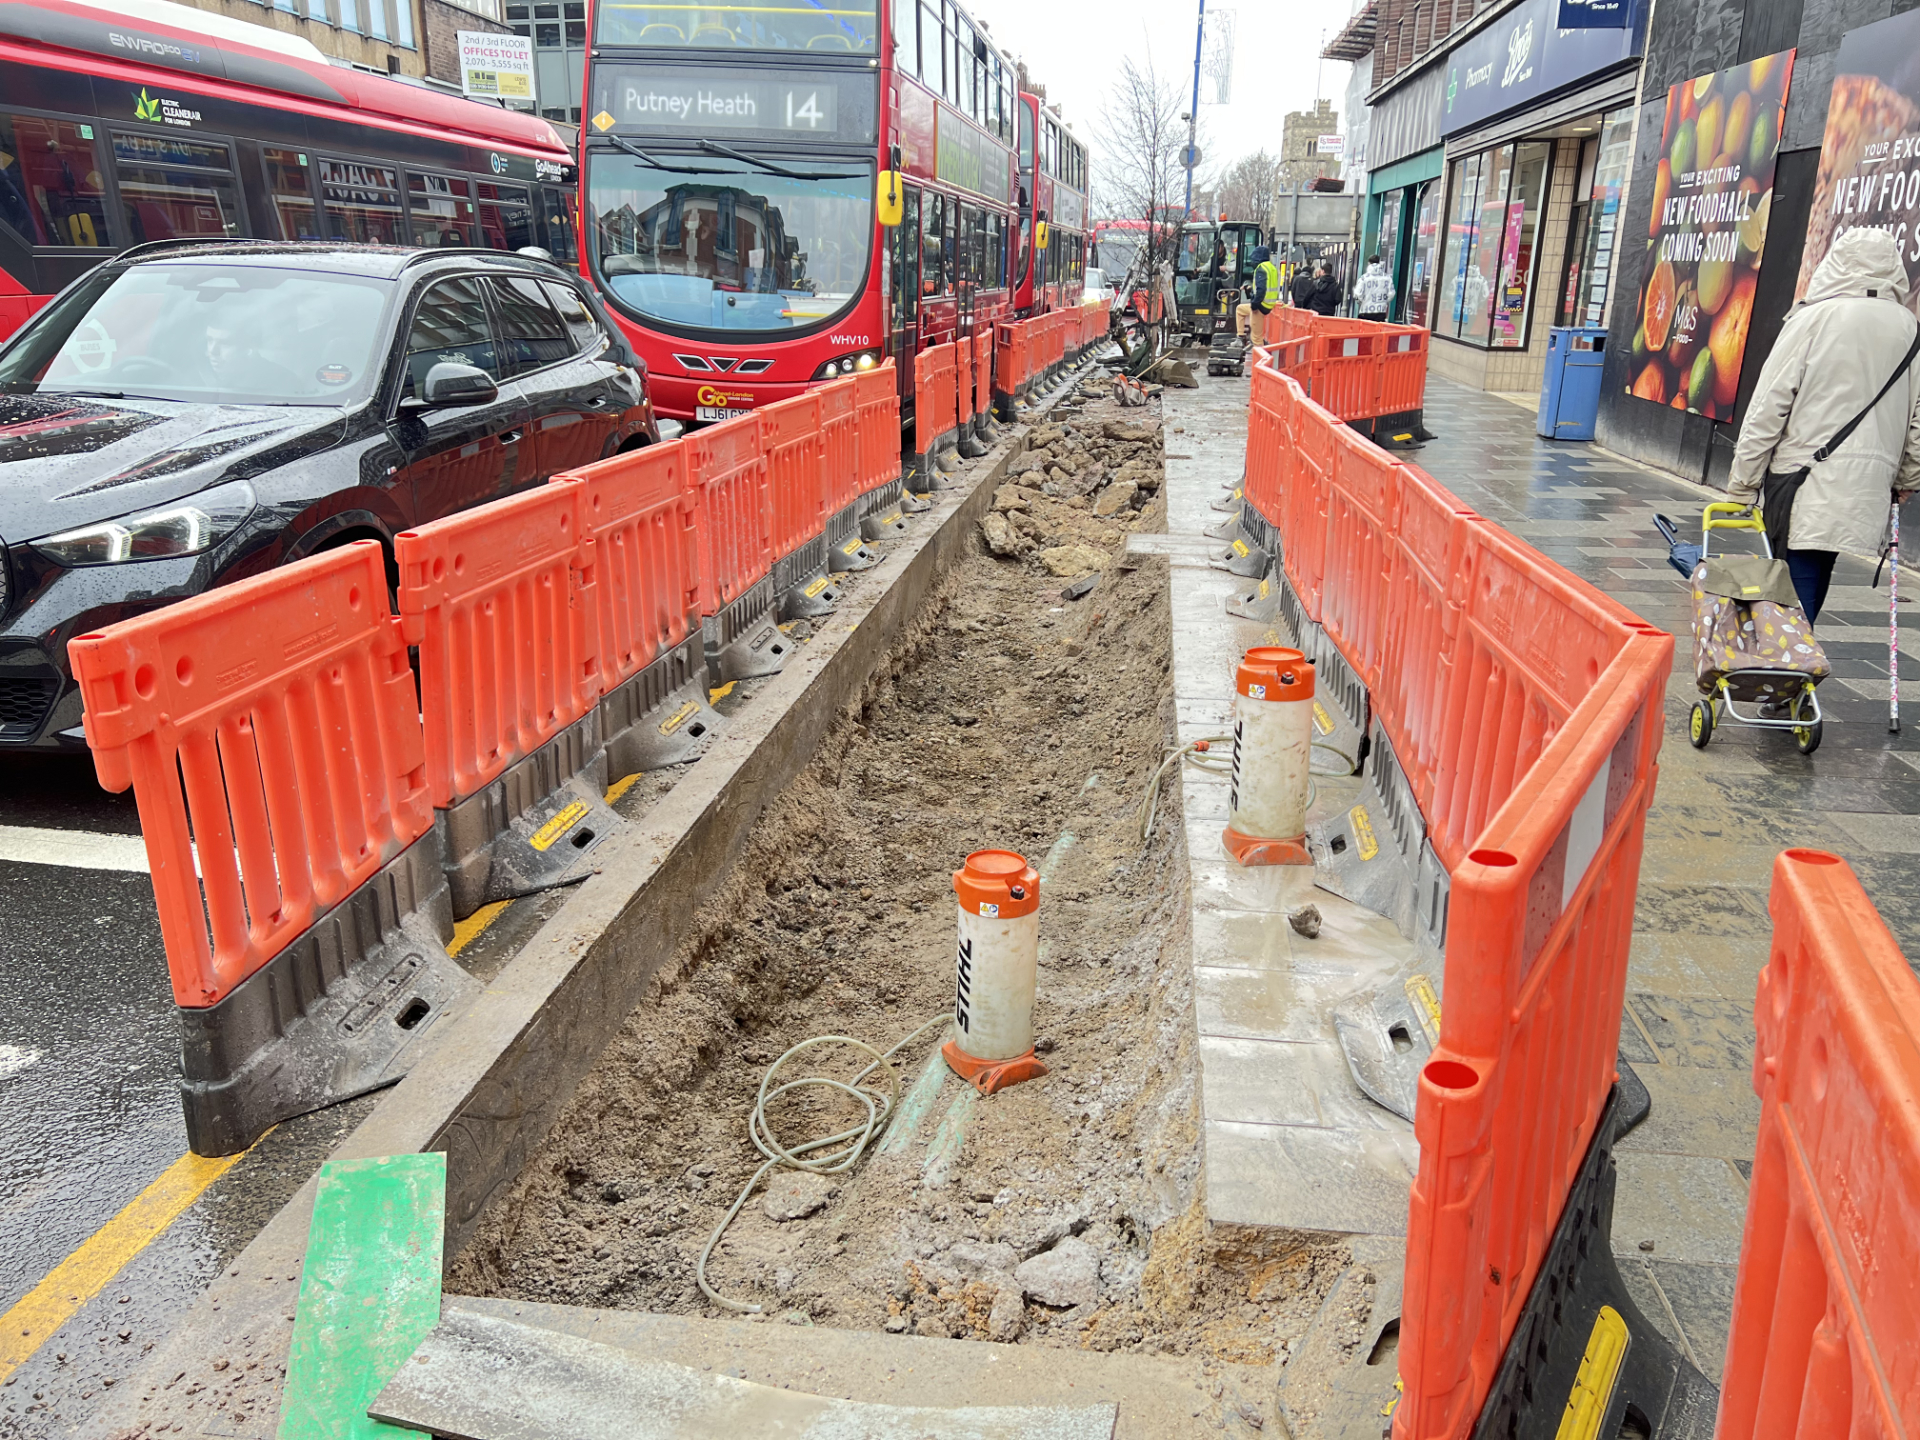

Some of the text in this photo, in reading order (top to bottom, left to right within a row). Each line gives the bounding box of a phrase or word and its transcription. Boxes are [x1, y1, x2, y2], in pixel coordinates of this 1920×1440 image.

[463, 46, 529, 60] OFFICES TO LET
[464, 35, 480, 45] 2nd
[486, 37, 499, 46] 3rd
[500, 38, 526, 49] FLOOR
[465, 57, 486, 67] 2,070
[491, 59, 512, 69] 5,555
[512, 63, 522, 71] sq
[523, 61, 529, 71] ft
[1464, 61, 1493, 91] Pharmacy
[625, 87, 756, 120] Putney Heath
[785, 90, 824, 129] 14
[1863, 141, 1890, 157] YOUR
[1680, 164, 1741, 187] YOUR EXCITING
[1831, 168, 1920, 215] NEW FOO
[1661, 189, 1751, 226] NEW FOODHALL
[1661, 230, 1740, 263] COMING SOON
[1673, 304, 1699, 331] M&S
[830, 334, 869, 346] WHV10
[697, 385, 728, 407] Go
[703, 407, 728, 420] LJ61
[957, 937, 973, 1035] STIHL
